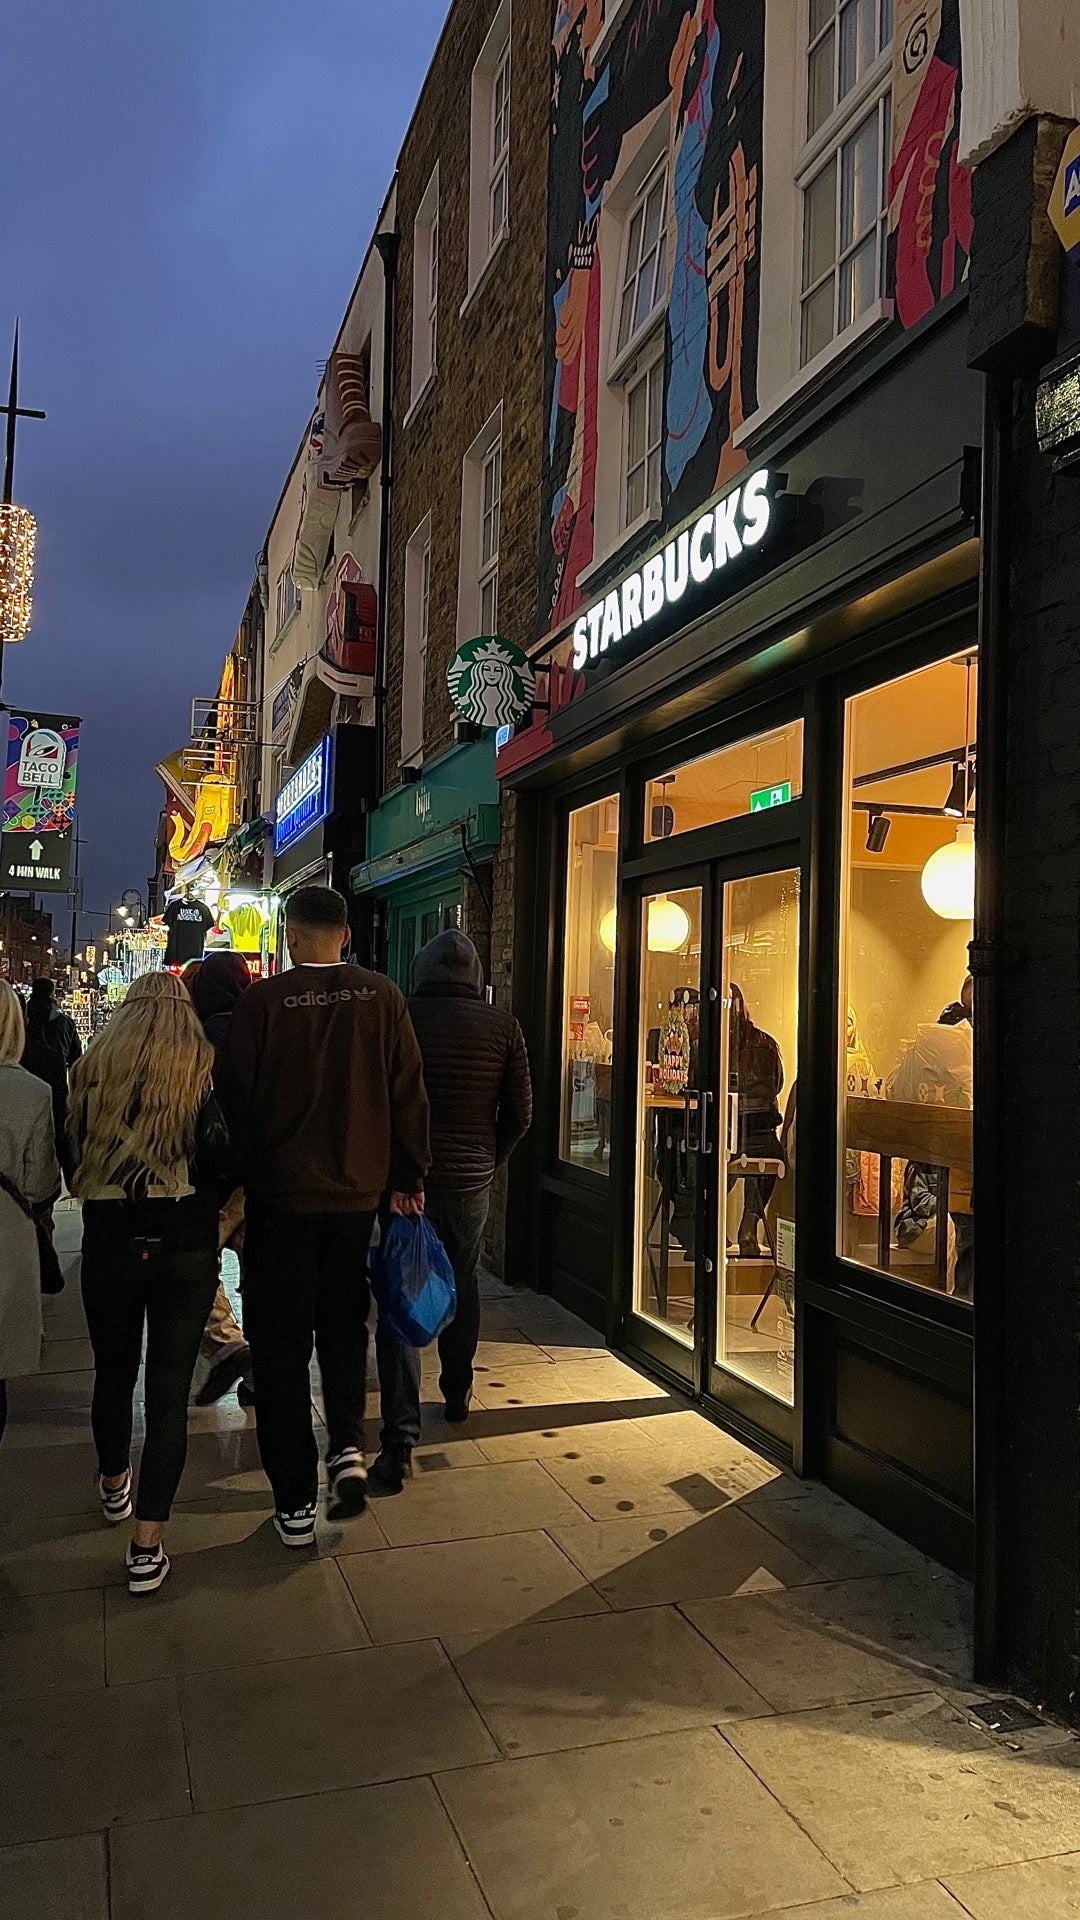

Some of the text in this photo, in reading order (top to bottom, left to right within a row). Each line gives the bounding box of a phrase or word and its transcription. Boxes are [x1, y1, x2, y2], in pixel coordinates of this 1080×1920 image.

[573, 469, 770, 670] STARBUCKS
[22, 760, 58, 773] TACO
[23, 773, 56, 784] BELL
[8, 864, 61, 880] 4 MIN WALK
[283, 989, 352, 1008] adidas
[663, 1054, 684, 1068] HAPPY
